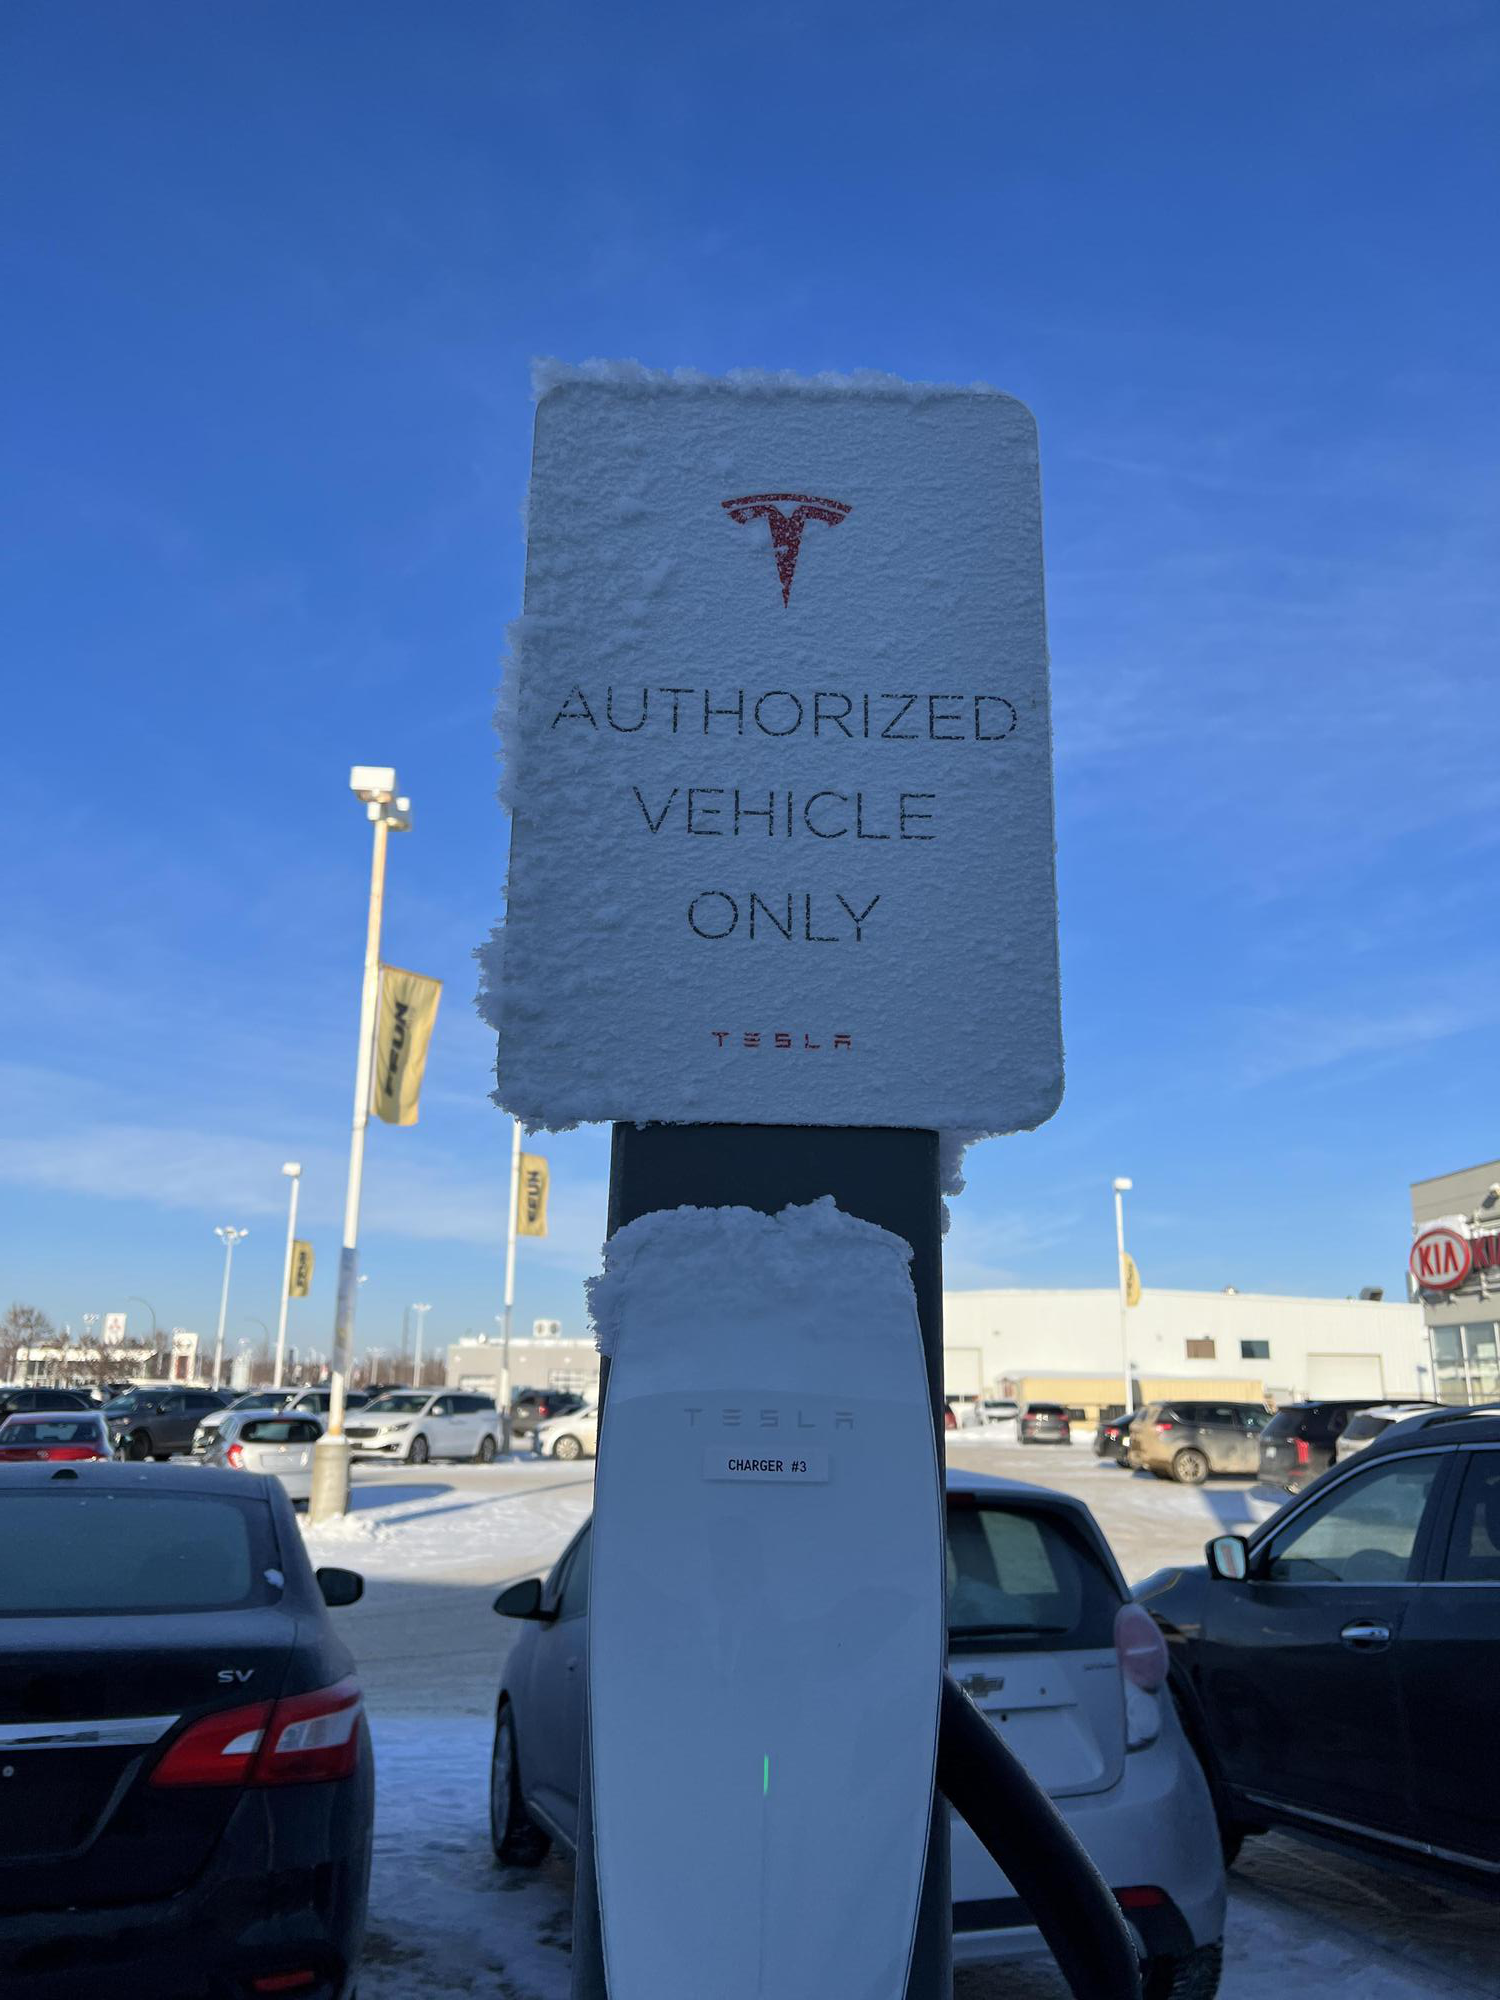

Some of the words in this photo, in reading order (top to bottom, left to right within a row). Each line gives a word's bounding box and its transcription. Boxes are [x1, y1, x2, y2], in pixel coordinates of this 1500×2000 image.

[553, 686, 1018, 741] AUTHORIZED
[633, 786, 937, 840] VEHICLE
[687, 890, 882, 942] ONLY
[385, 1000, 410, 1097] FFUN
[711, 1030, 854, 1050] TESLA
[1418, 1241, 1459, 1277] KIA
[1472, 1233, 1500, 1270] KI
[684, 1407, 855, 1430] TESLA
[728, 1459, 784, 1472] CHARGER
[791, 1459, 808, 1473] #3
[217, 1669, 254, 1683] SV
